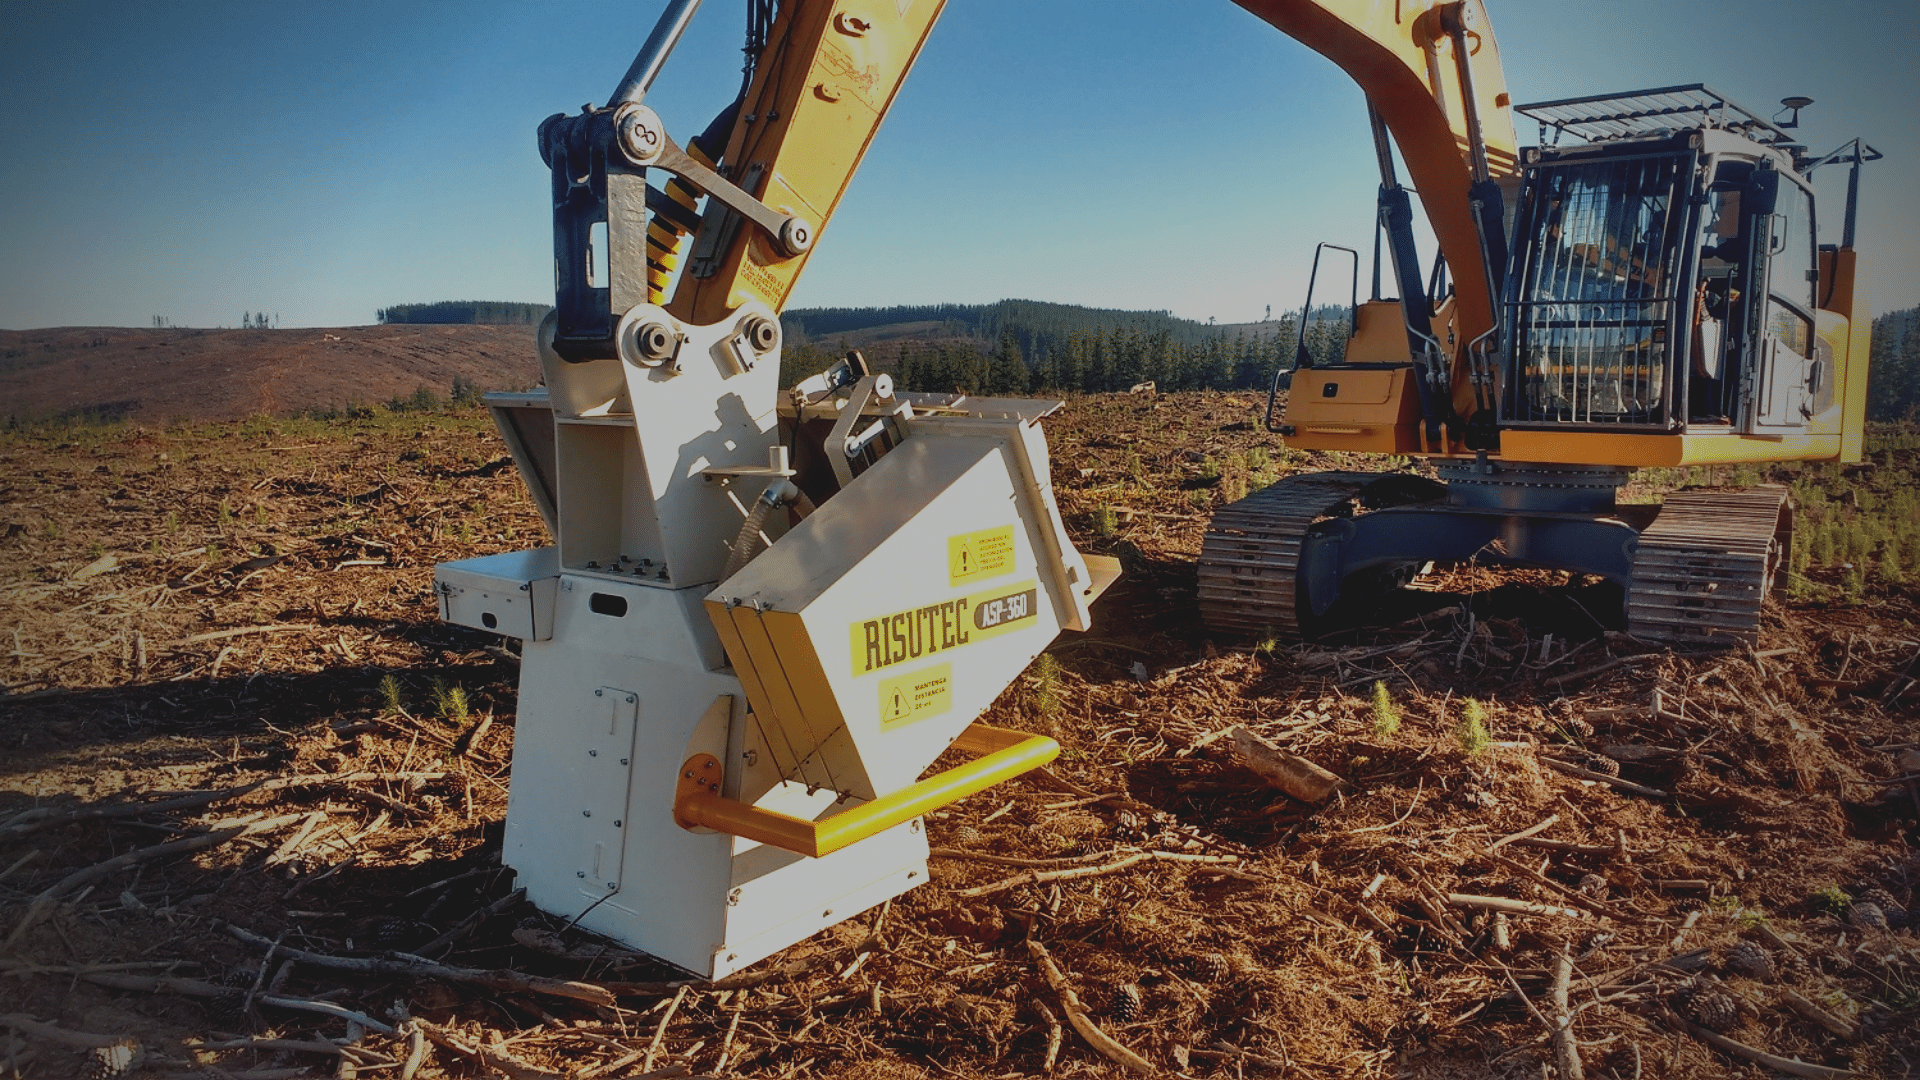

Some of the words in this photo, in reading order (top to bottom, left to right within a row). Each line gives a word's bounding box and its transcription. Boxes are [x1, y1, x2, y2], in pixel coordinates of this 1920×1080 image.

[864, 598, 969, 671] RISUTEC
[982, 593, 1027, 627] ASP-360
[914, 676, 947, 691] MANTENGA
[914, 686, 946, 701] DISTANCIA
